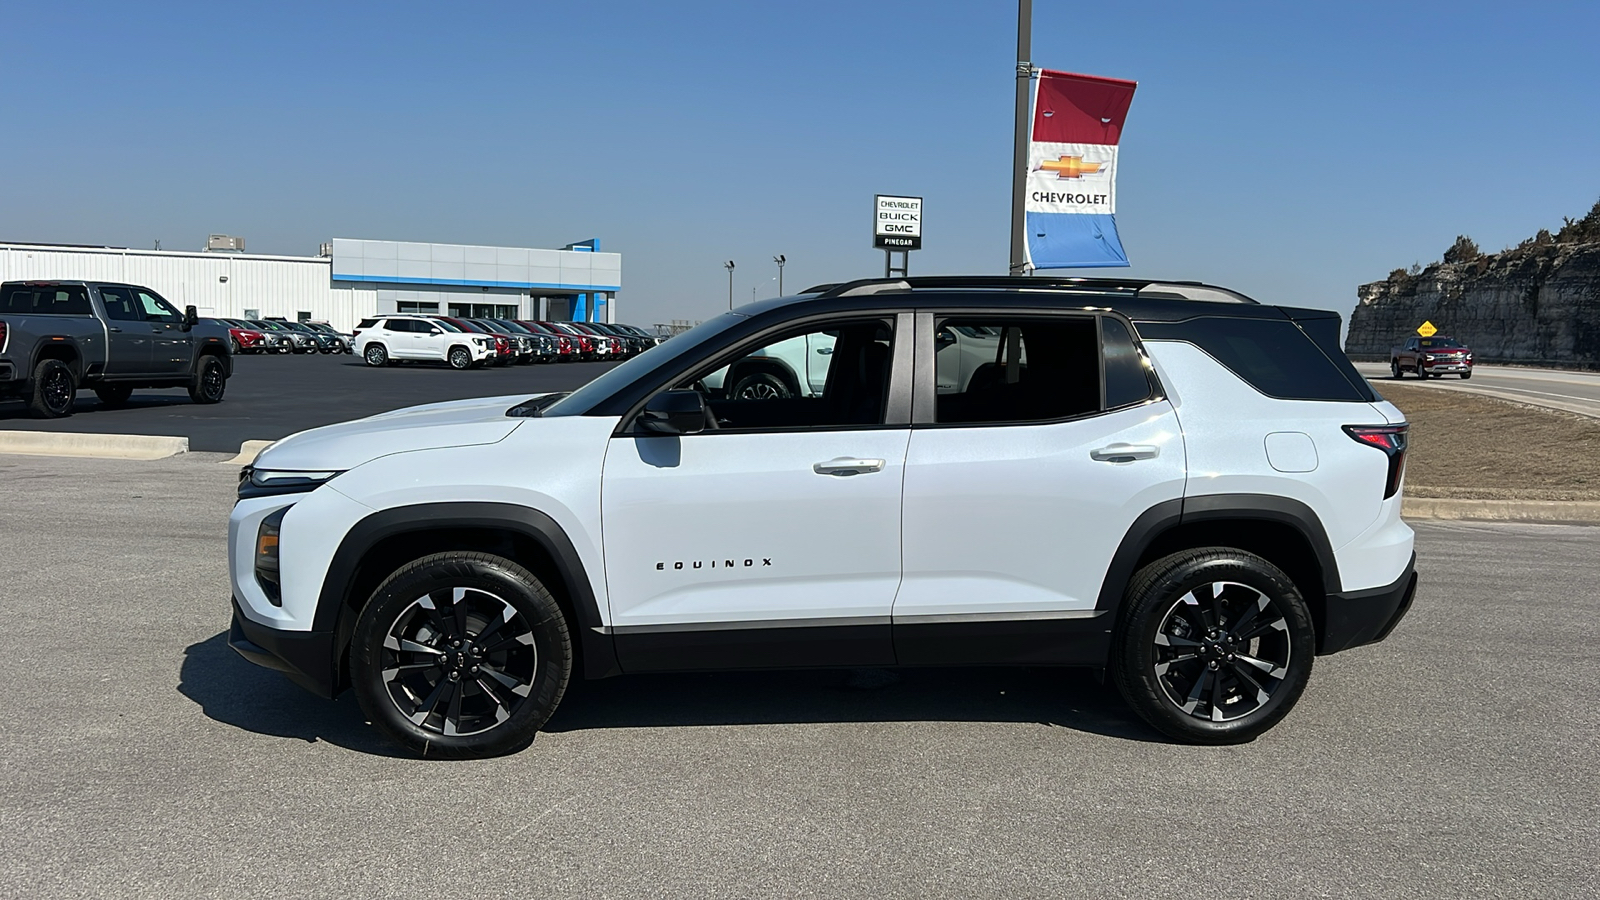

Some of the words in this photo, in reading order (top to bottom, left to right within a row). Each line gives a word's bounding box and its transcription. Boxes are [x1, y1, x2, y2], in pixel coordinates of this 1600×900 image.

[1032, 191, 1108, 205] CHEVROLET
[880, 200, 919, 209] CHEVROLET
[880, 212, 919, 221] BUICK
[885, 224, 913, 232] GMC
[884, 238, 913, 246] PINEGAR
[656, 558, 772, 570] EQUINOX
